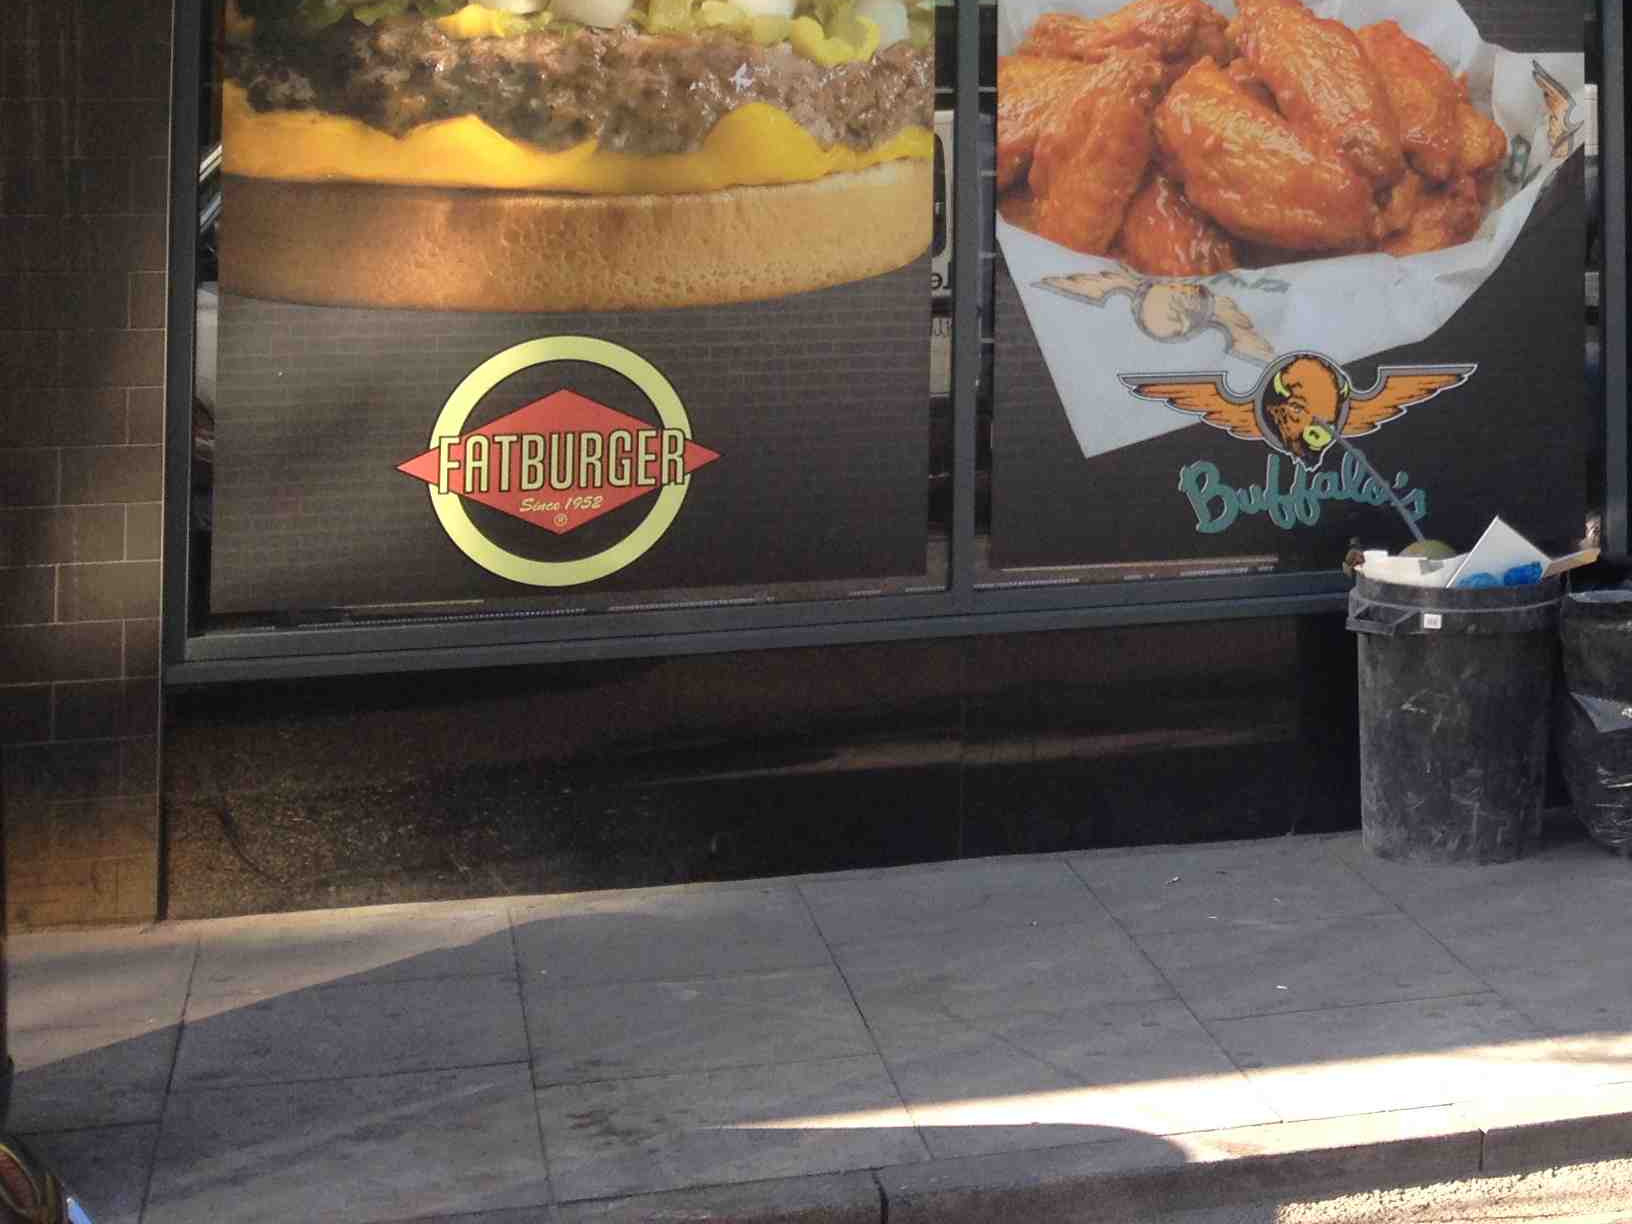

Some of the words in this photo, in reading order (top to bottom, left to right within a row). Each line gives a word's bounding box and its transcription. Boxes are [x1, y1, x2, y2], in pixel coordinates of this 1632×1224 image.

[438, 428, 687, 495] FATBURGER
[1178, 453, 1429, 534] Buffalo's
[519, 497, 561, 513] Since
[564, 495, 605, 511] 1952
